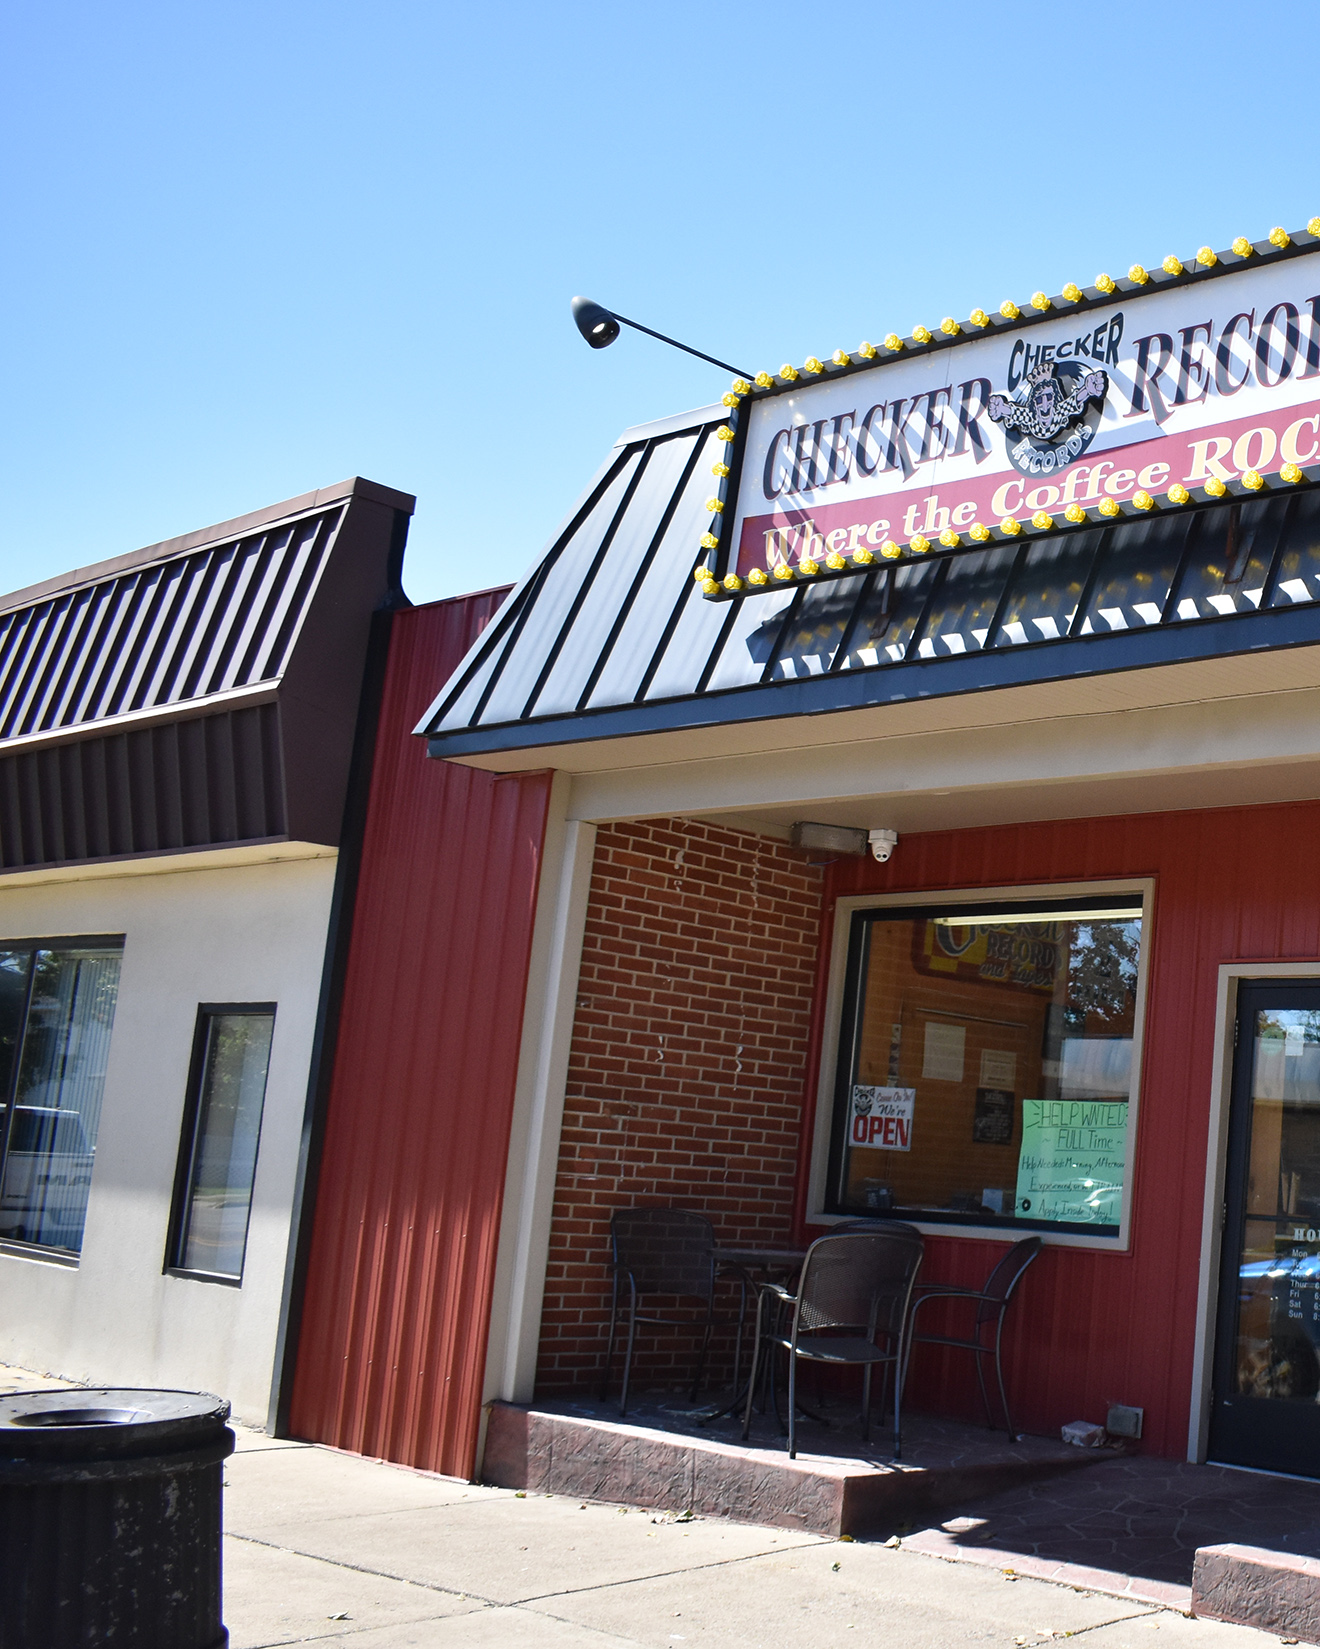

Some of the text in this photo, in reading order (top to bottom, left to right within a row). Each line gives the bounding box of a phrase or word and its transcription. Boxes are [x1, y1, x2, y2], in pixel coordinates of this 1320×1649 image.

[1007, 312, 1124, 393] CHECKER
[763, 377, 992, 500] CHECKER
[1012, 423, 1093, 474] RECORDS
[763, 519, 890, 570] Where
[903, 495, 977, 537] the
[991, 461, 1171, 517] Coffee
[987, 932, 1063, 971] RECORDS
[979, 962, 1007, 978] and
[879, 1104, 906, 1116] We're
[1041, 1101, 1080, 1127] HELP
[853, 1115, 910, 1147] OPEN
[1057, 1129, 1114, 1150] FULL Time
[1292, 1249, 1308, 1257] Mon
[1290, 1290, 1300, 1298] Fri
[1291, 1280, 1307, 1288] Thur
[1288, 1310, 1303, 1319] Sun
[1289, 1300, 1301, 1308] Sat
